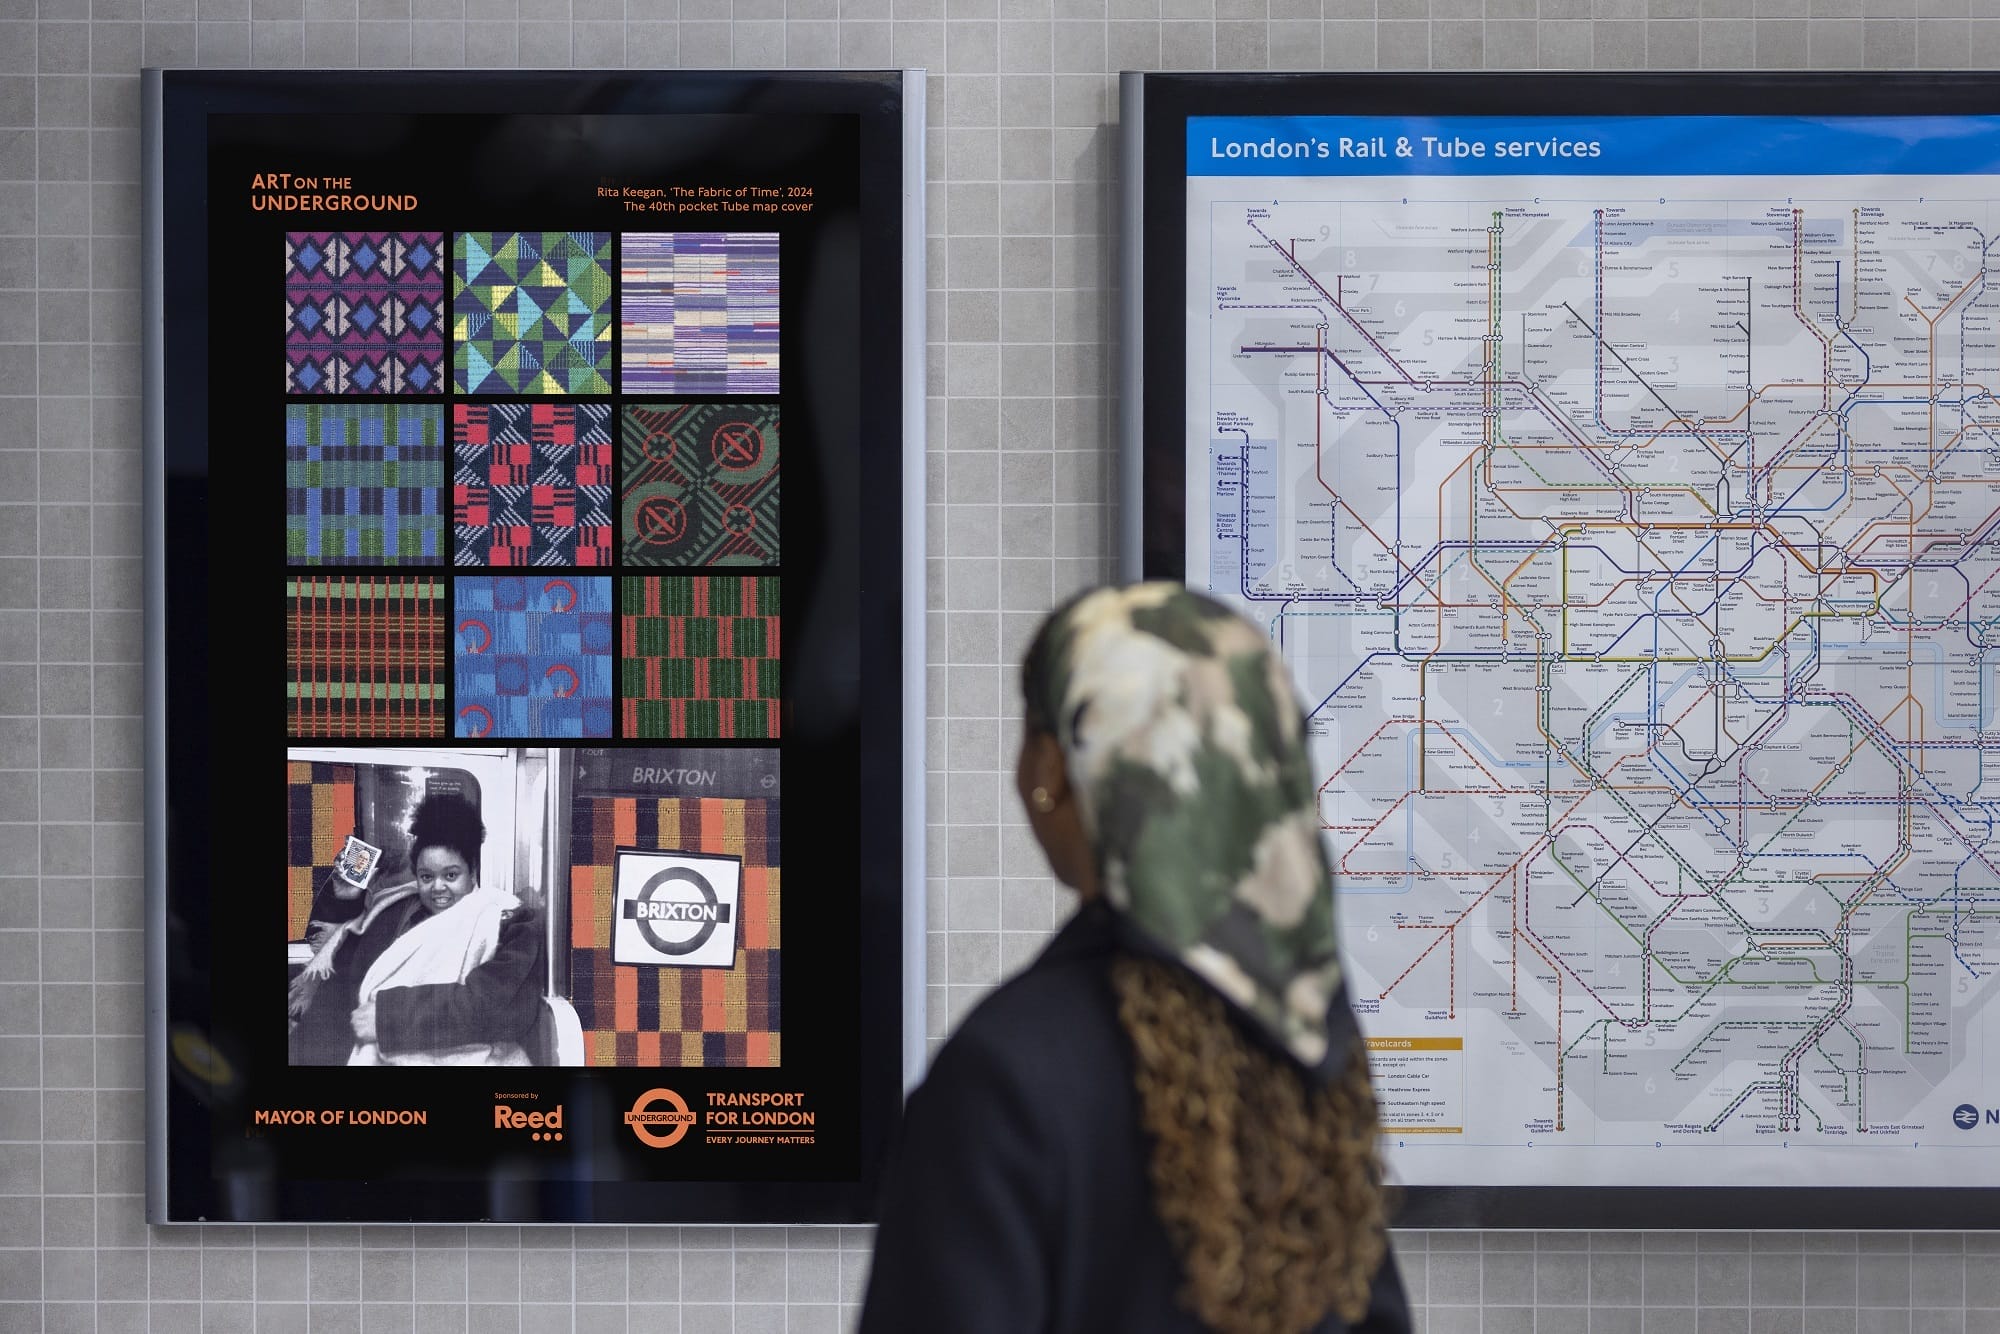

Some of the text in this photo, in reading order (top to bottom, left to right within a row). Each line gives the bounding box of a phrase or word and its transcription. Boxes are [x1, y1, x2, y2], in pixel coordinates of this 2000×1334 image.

[1211, 136, 1601, 158] London’s Rail & Tube services
[253, 174, 349, 188] ART ON THE
[597, 187, 814, 199] Rita Keegan, ‘The Fabric of Time’, 2024
[252, 195, 417, 210] UNDERGROUND
[623, 202, 814, 213] The 40th pocket Tube map cover
[1319, 225, 1330, 241] 9
[1345, 249, 1356, 268] 8
[1369, 274, 1380, 290] 7
[1422, 329, 1434, 346] 5
[633, 767, 716, 786] BRIXTON
[637, 901, 718, 921] BRIXTON
[530, 1092, 539, 1100] by
[708, 1093, 803, 1105] TRANSPORT
[256, 1111, 426, 1124] MAYOR OF LONDON
[495, 1105, 562, 1128] Reed
[627, 1114, 693, 1122] UNDERGROUND
[706, 1112, 814, 1125] FOR LONDON
[706, 1136, 815, 1144] EVERY JOURNEY MATTERS
